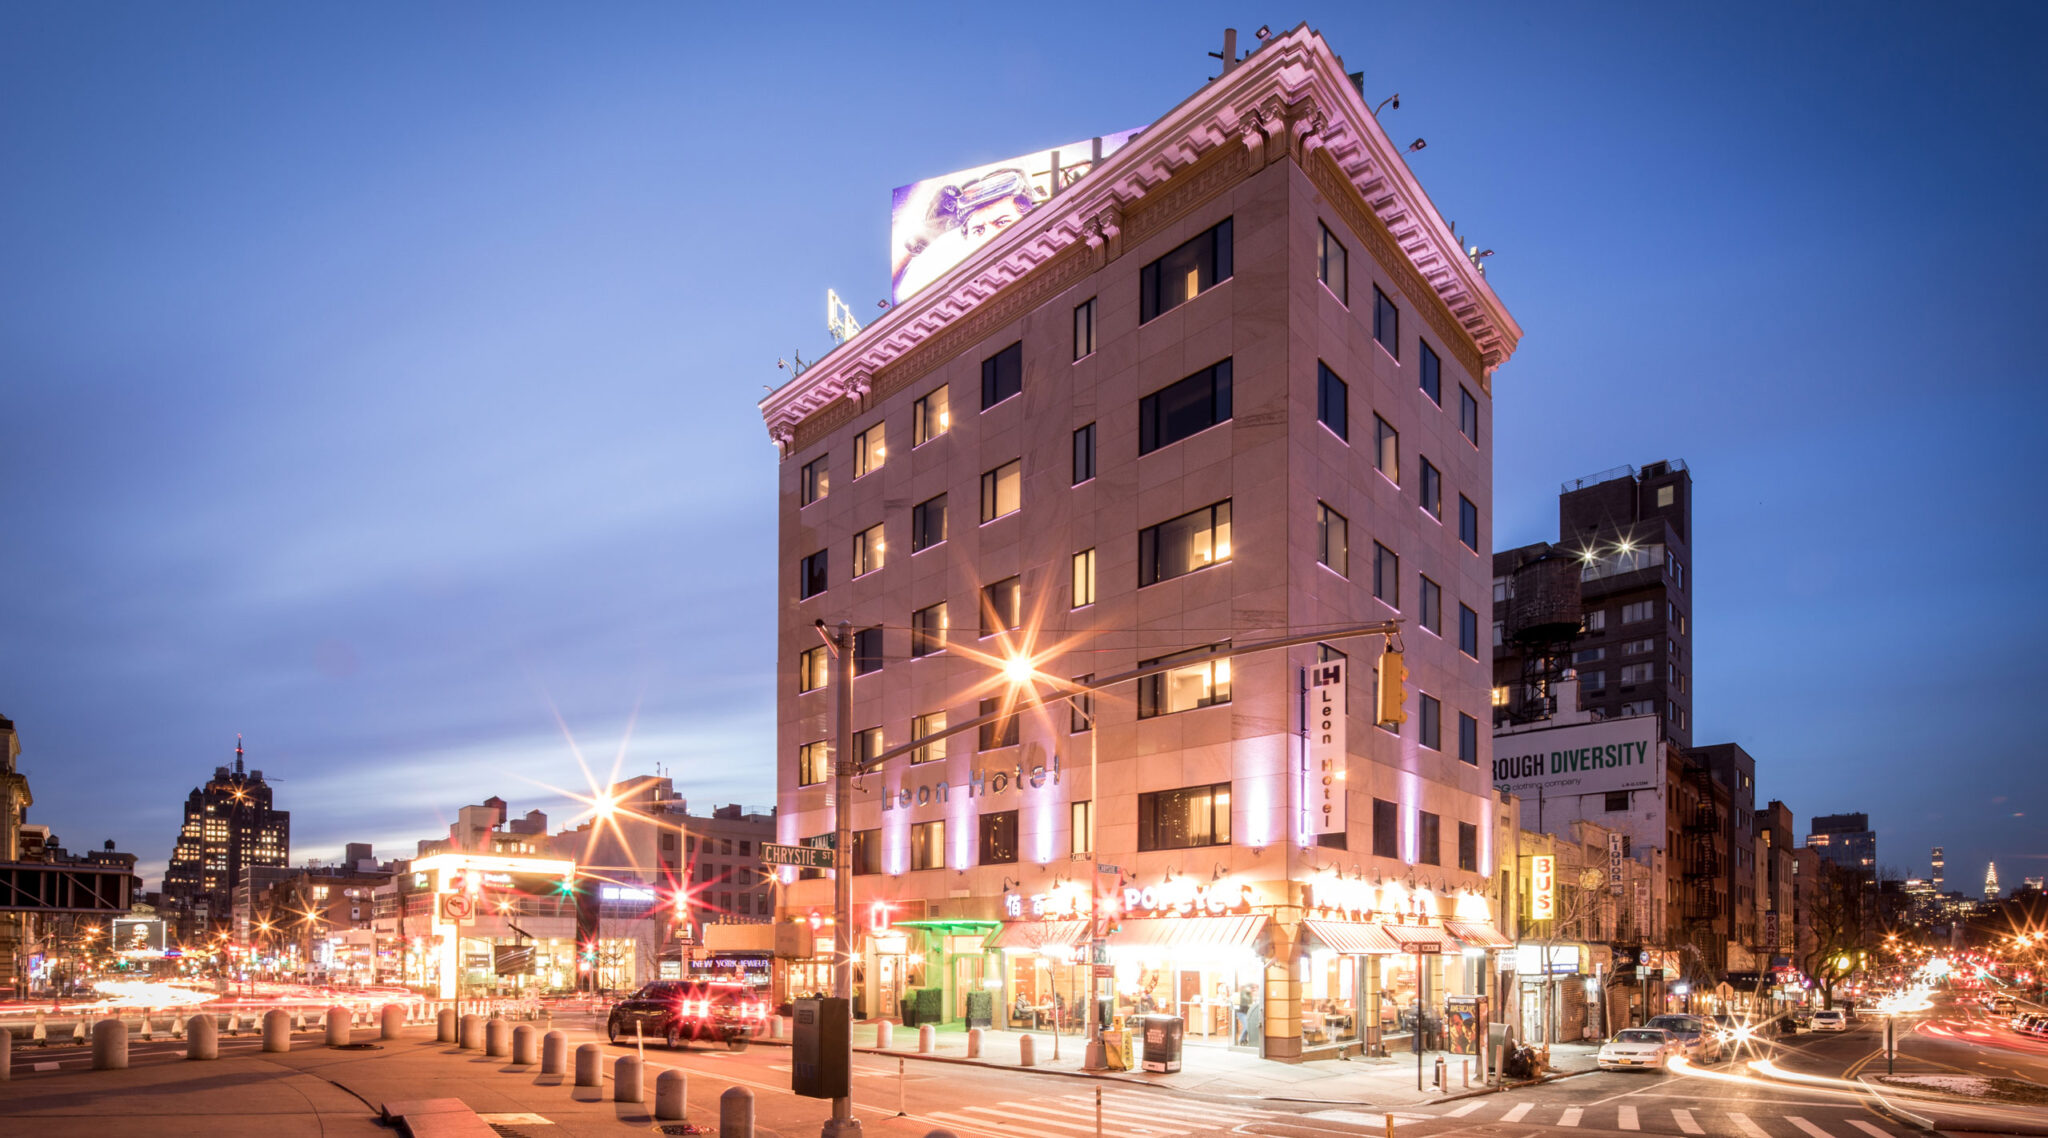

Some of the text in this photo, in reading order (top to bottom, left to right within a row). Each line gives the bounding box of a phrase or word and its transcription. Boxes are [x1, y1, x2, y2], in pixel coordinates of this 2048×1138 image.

[1321, 690, 1333, 828] Leon Hotel
[1551, 741, 1648, 774] DIVERSITY
[882, 755, 1060, 811] Leon Hotel
[1512, 780, 1543, 791] clothing
[1544, 777, 1582, 788] company
[765, 846, 831, 866] CHRYSTIE ST
[811, 836, 830, 849] CANAL
[1611, 835, 1621, 880] LIQUOR
[1537, 858, 1551, 910] BUS
[1767, 916, 1776, 945] PARK
[692, 960, 713, 968] NEW
[715, 960, 737, 968] YORK
